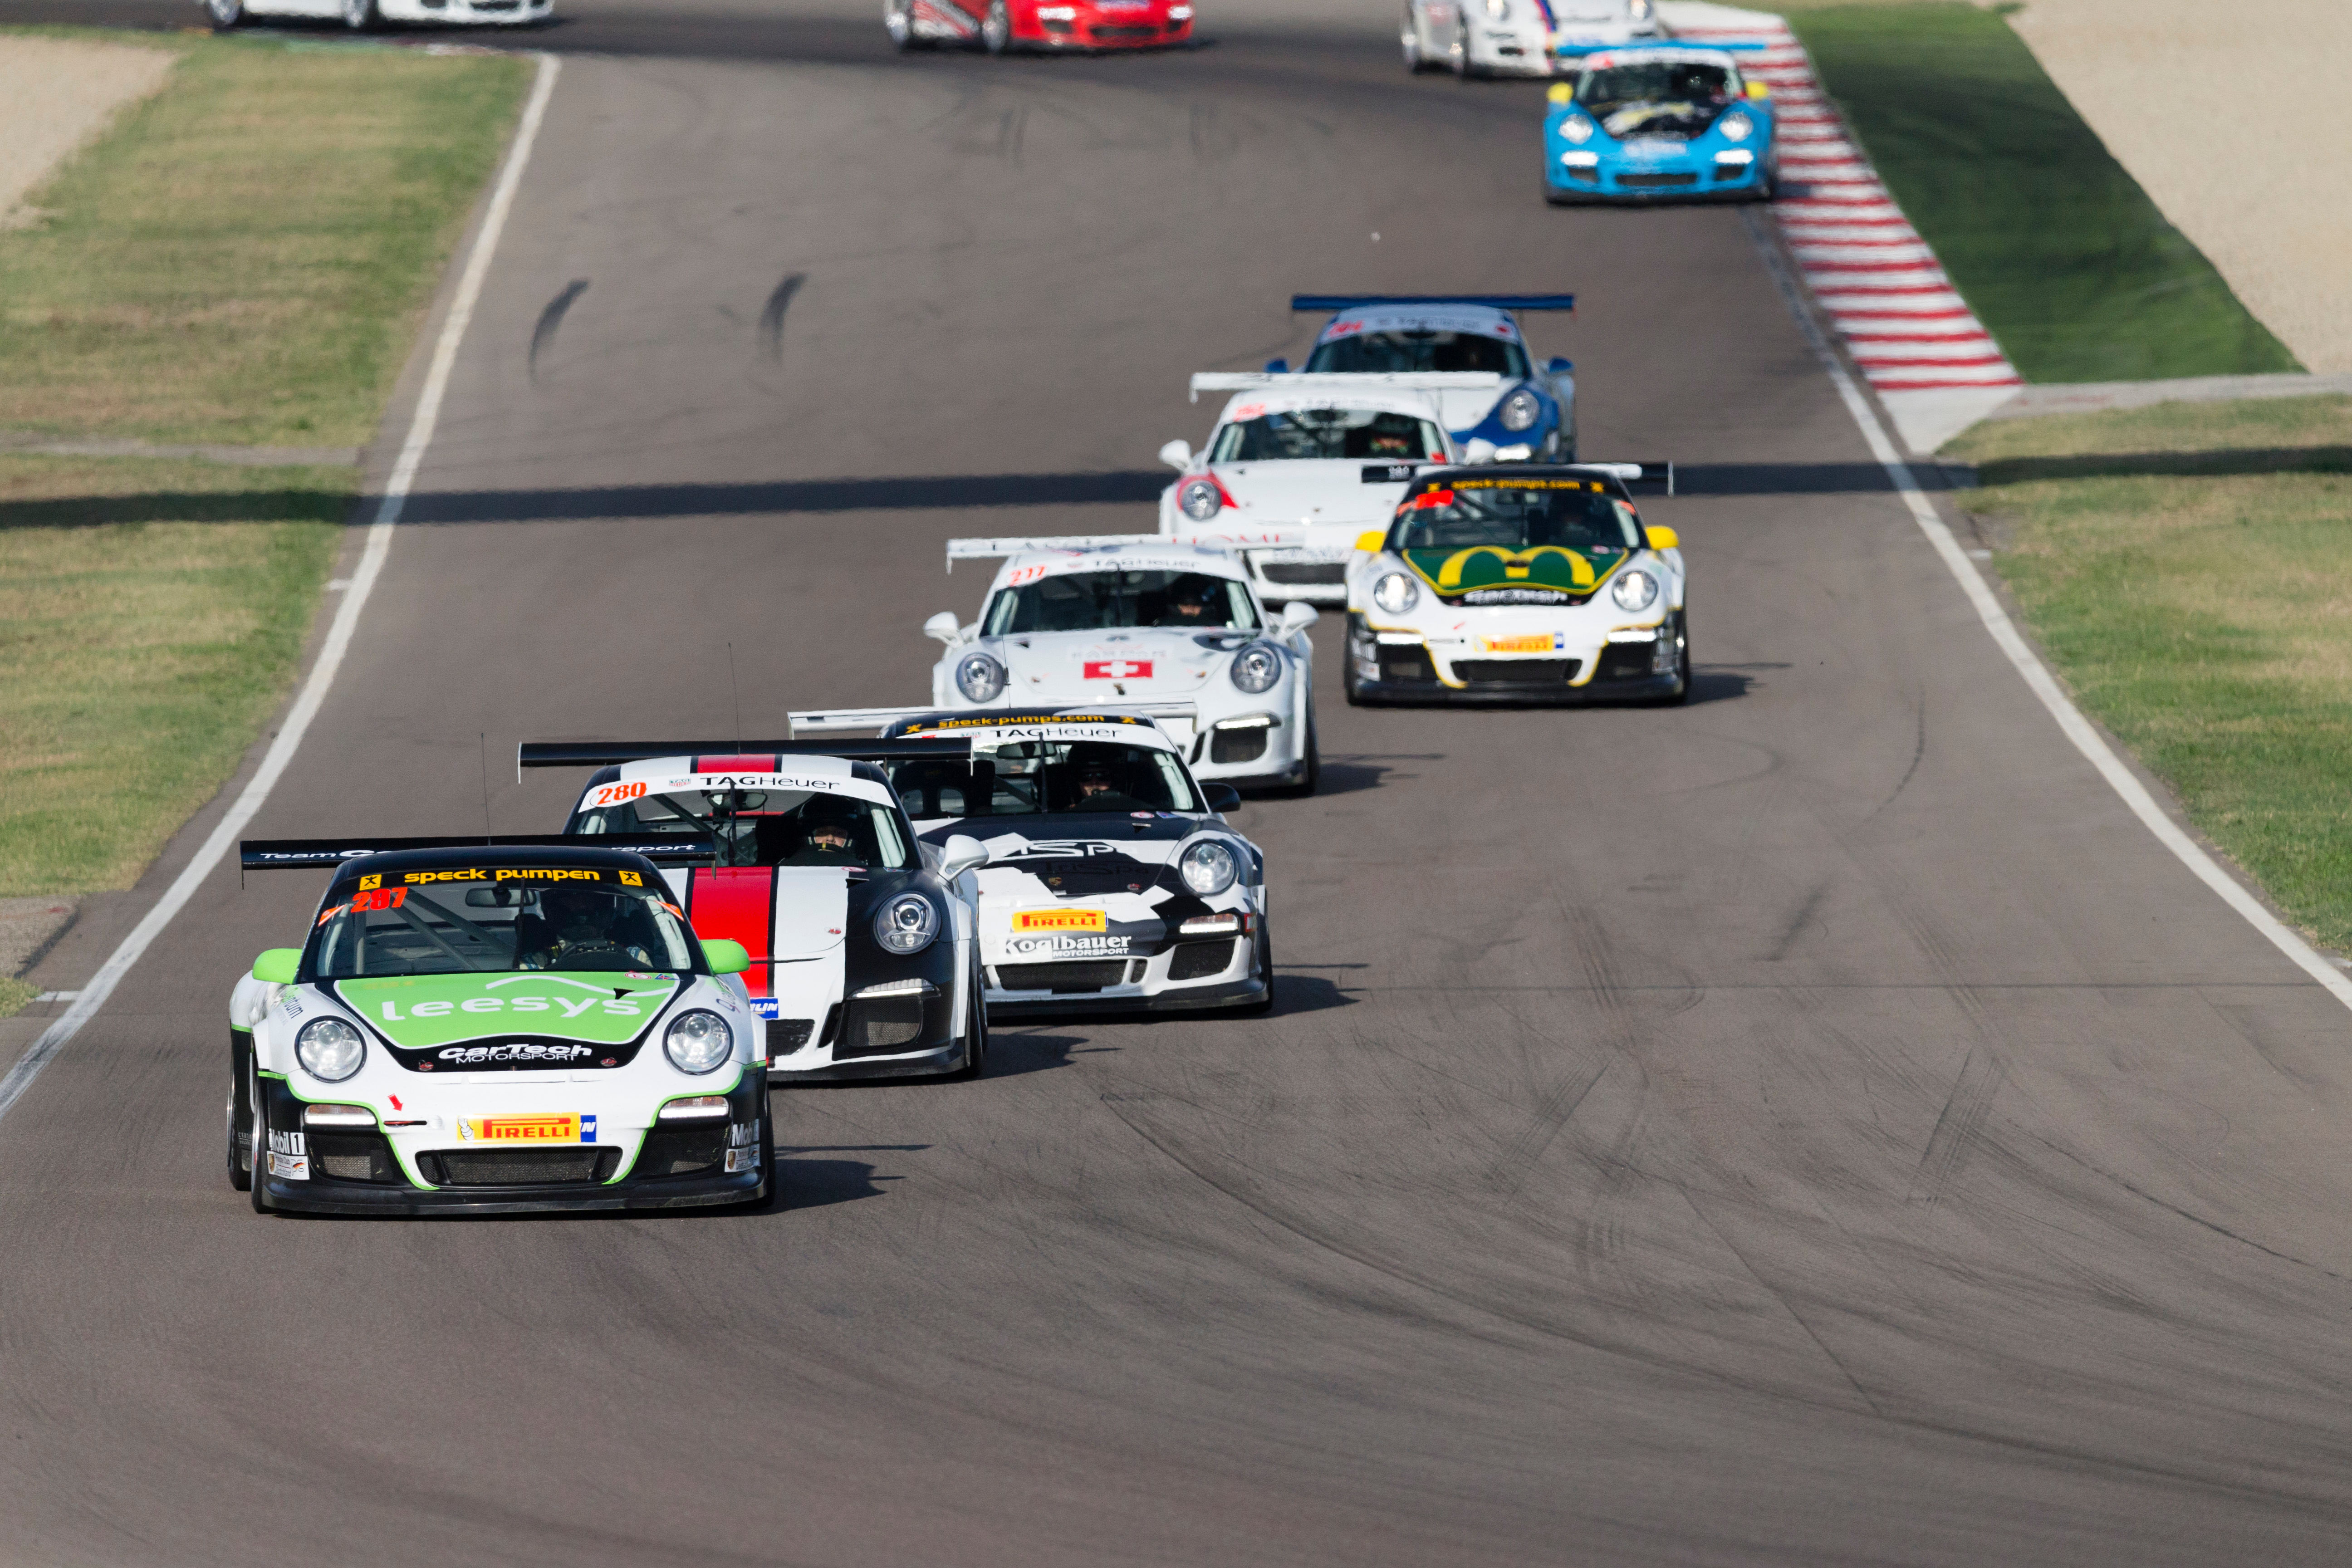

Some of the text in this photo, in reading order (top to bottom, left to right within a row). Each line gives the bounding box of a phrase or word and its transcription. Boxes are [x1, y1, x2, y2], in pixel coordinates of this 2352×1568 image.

[938, 715, 1104, 729] speck-pumps.com
[990, 728, 1123, 737] TAGHeuer
[700, 776, 840, 789] TAGHeuer
[597, 782, 647, 805] 280
[404, 869, 600, 885] speck pumpen
[351, 887, 408, 913] 297
[1022, 912, 1097, 927] PIRELLI
[1005, 936, 1132, 956] Koglbauer
[1052, 948, 1129, 957] MOTORSPORT
[382, 997, 641, 1021] leesys
[438, 1044, 592, 1059] CarTech
[456, 1052, 578, 1064] MOTORSPORT
[483, 1117, 571, 1138] PIRELLI
